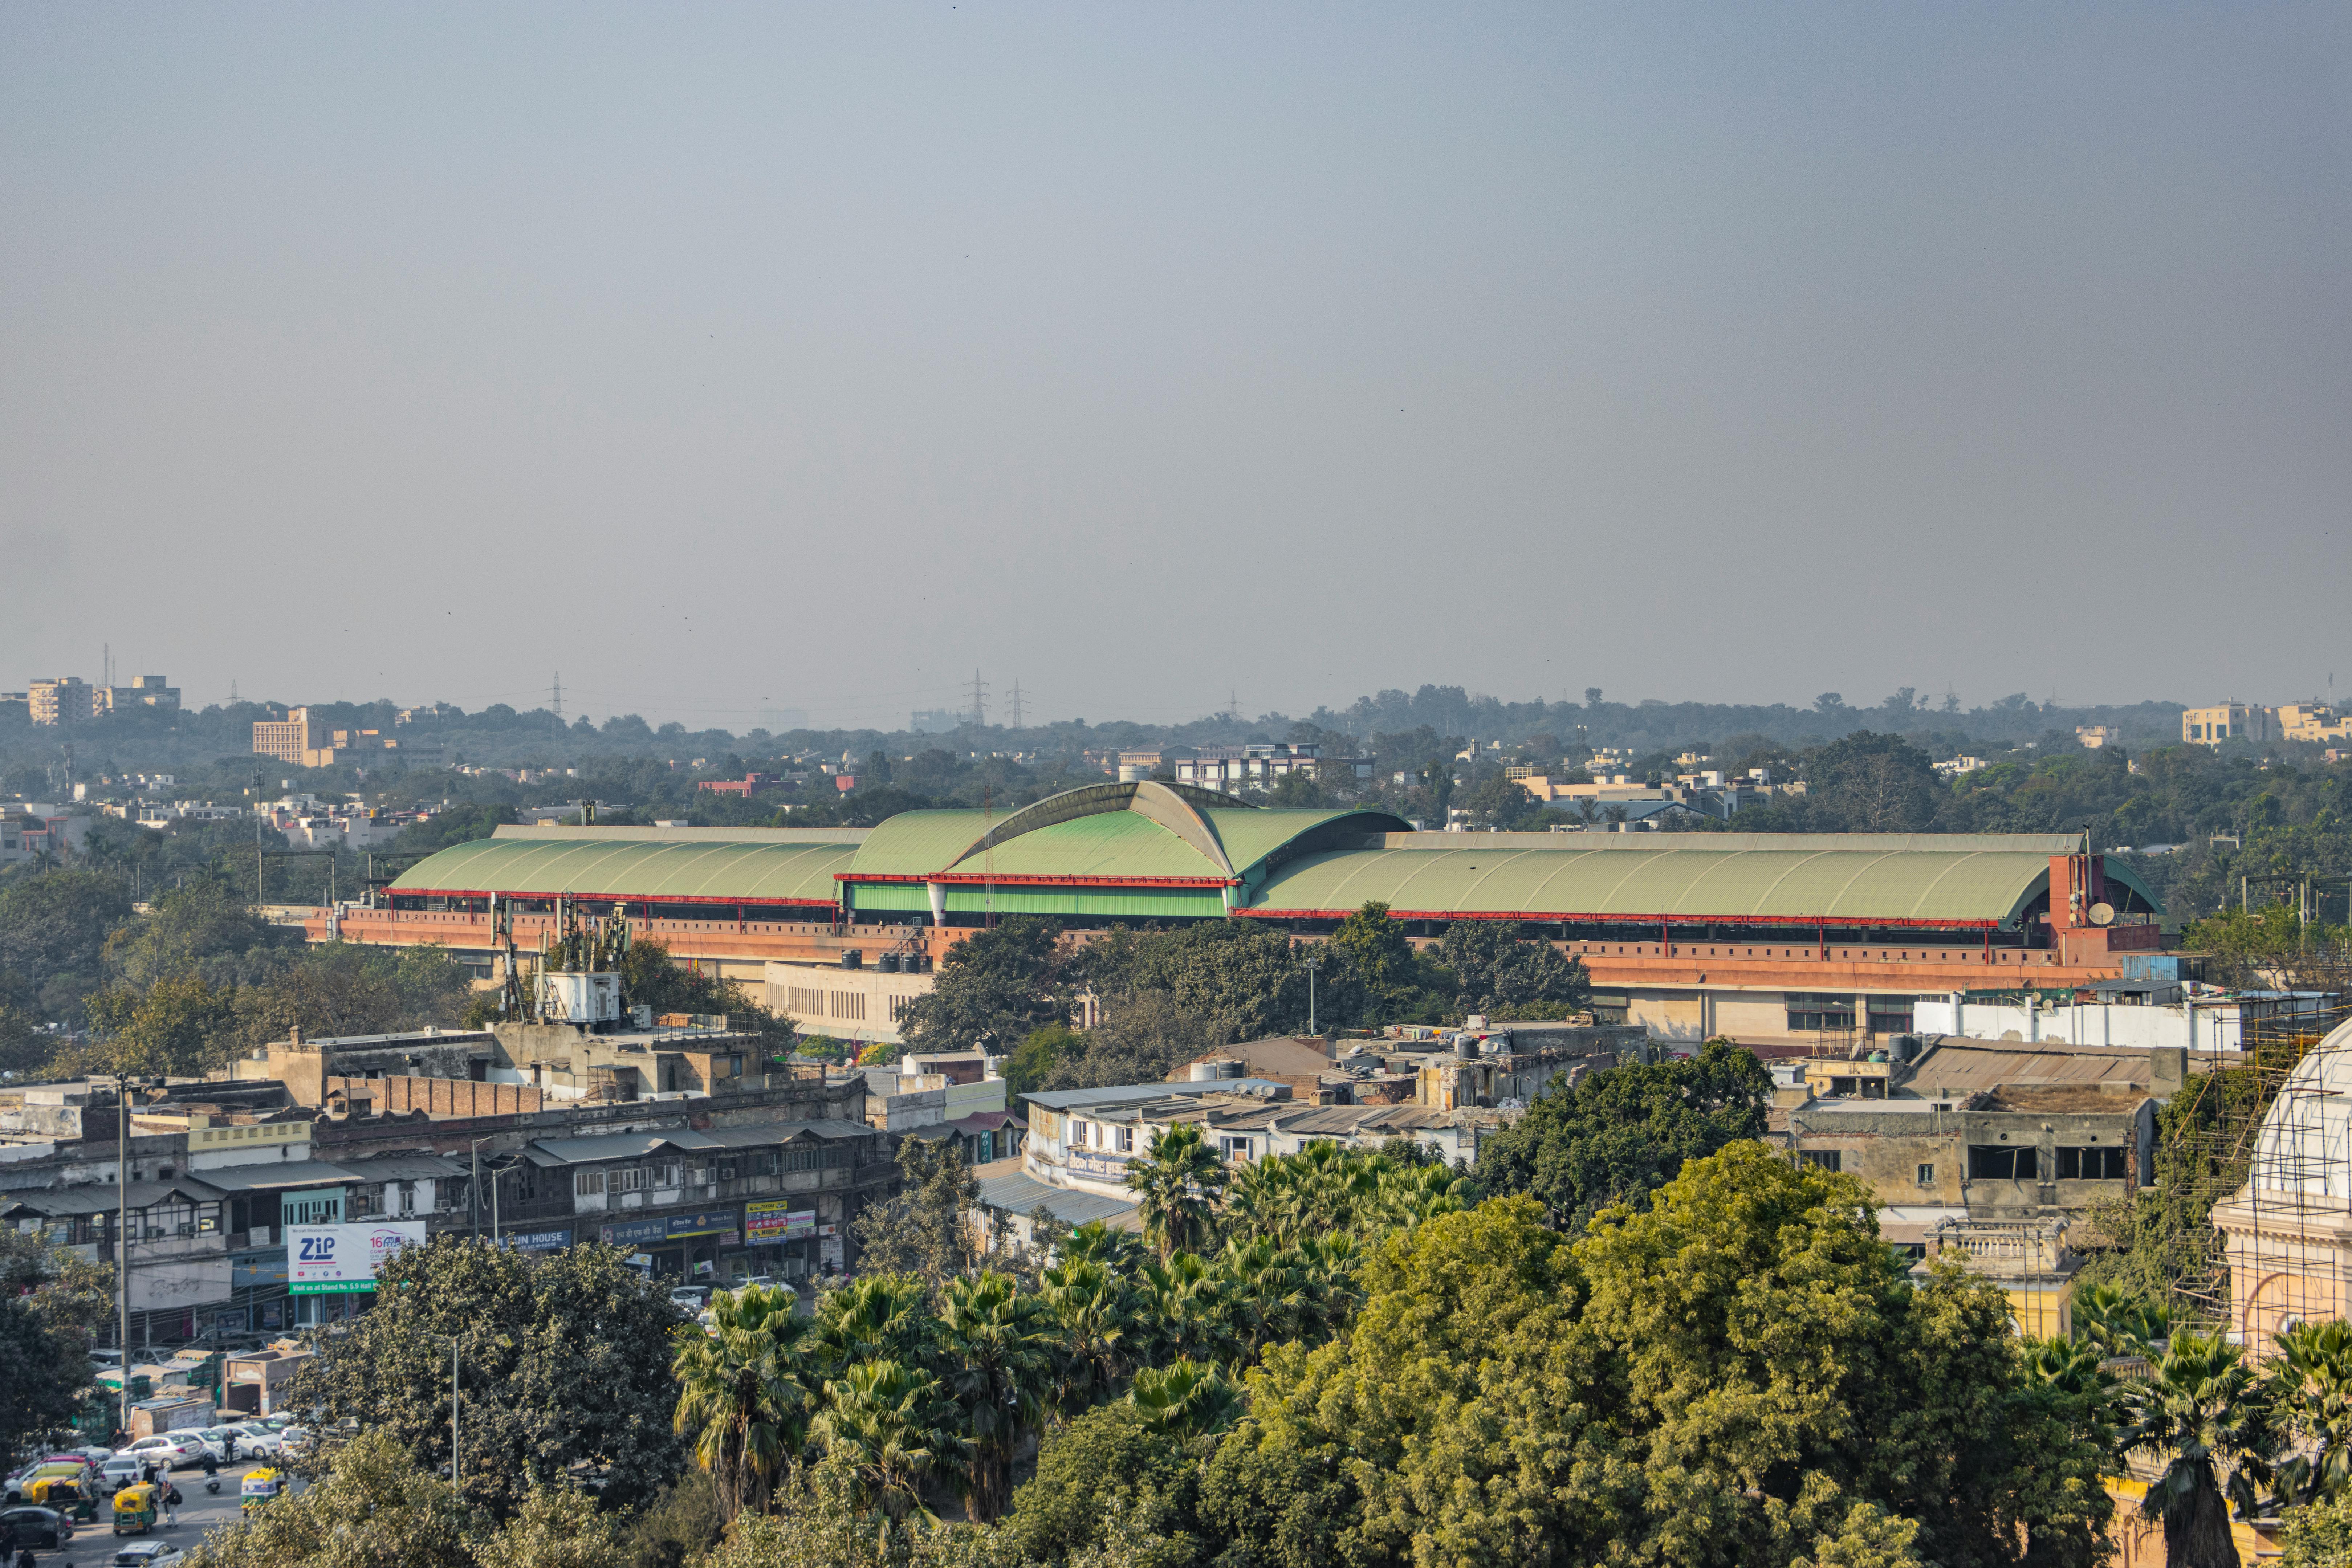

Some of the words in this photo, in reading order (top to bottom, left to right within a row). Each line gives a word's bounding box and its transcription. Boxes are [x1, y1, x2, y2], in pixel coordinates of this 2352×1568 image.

[626, 1228, 632, 1237] डी
[643, 1226, 650, 1235] सी
[652, 1225, 662, 1234] बैंक
[370, 1237, 383, 1248] 16
[532, 1232, 562, 1243] HOUSE
